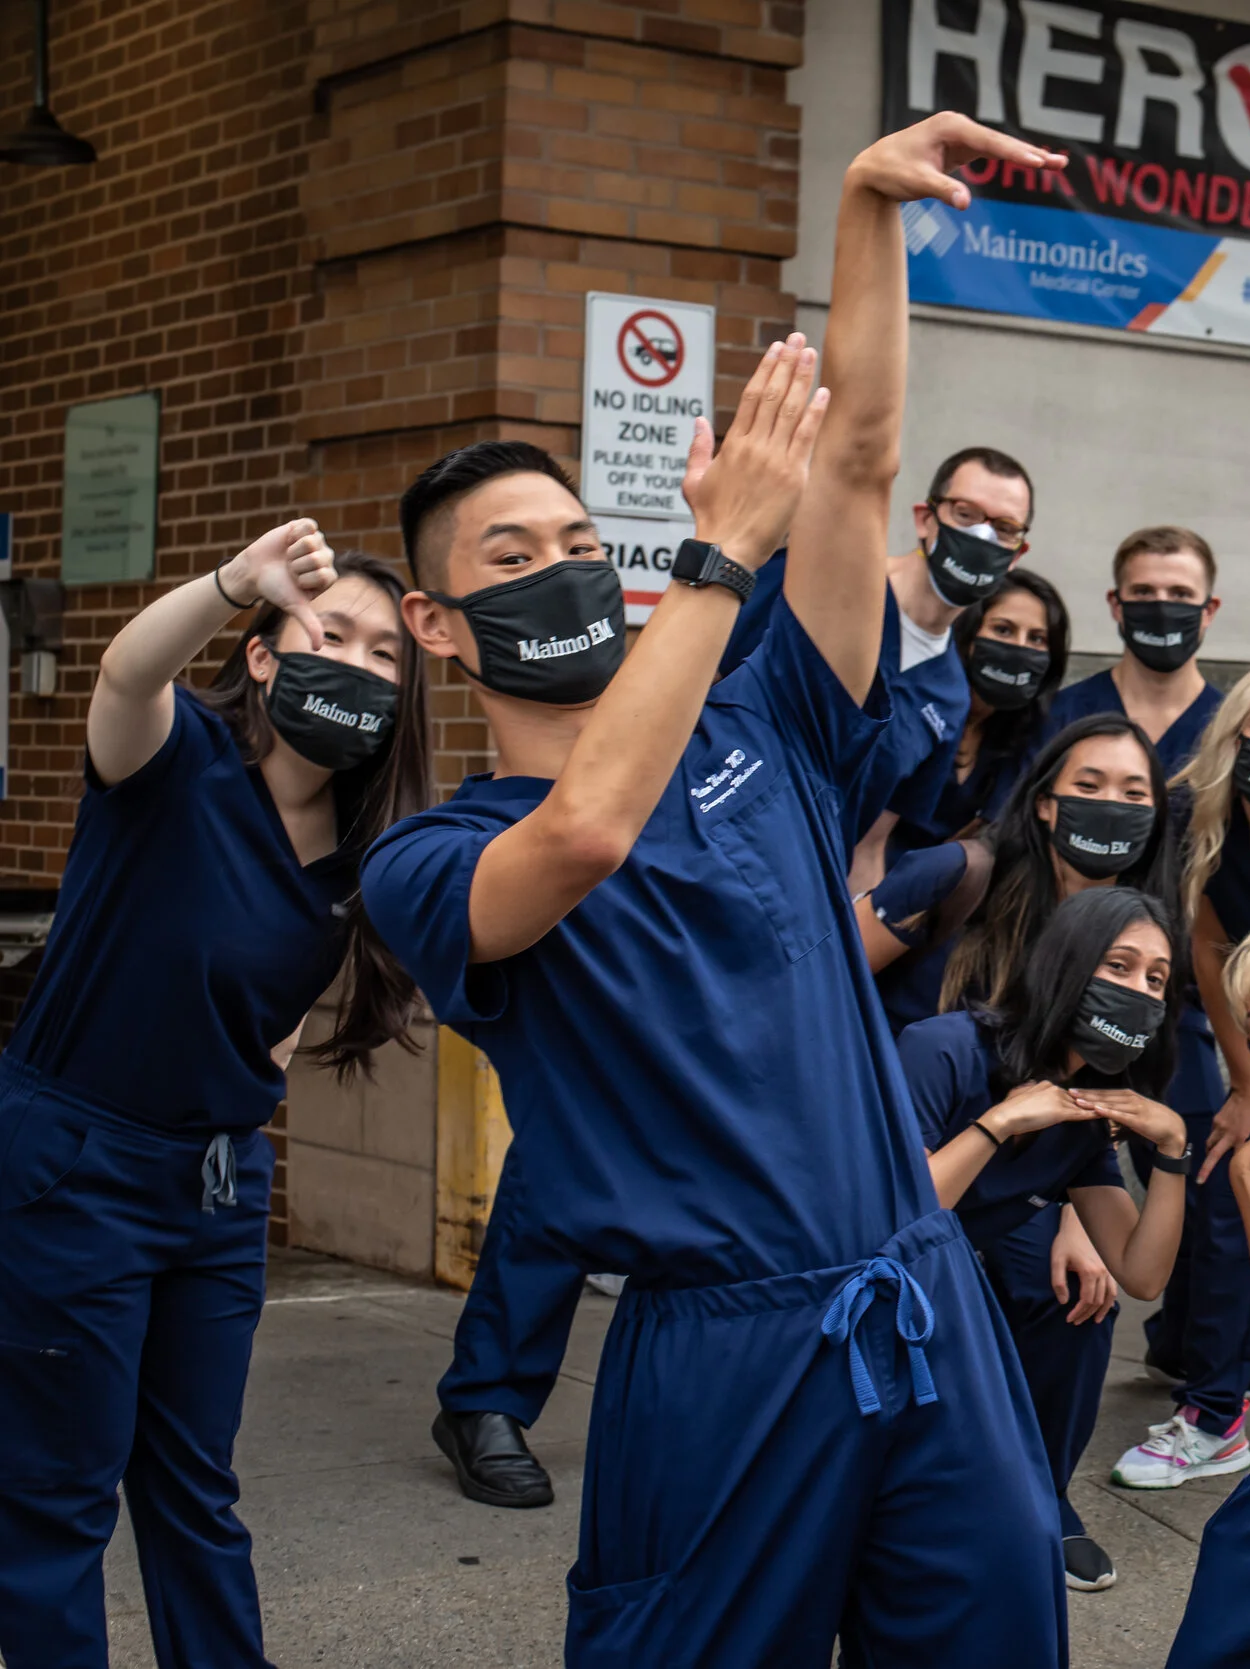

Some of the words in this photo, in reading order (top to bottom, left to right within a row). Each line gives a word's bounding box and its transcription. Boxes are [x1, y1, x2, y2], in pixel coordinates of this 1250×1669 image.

[963, 221, 1149, 279] Maimonides
[1029, 270, 1090, 295] Medical
[593, 389, 626, 411] NO
[632, 393, 704, 418] IDLING
[617, 421, 678, 446] ZONE
[592, 450, 653, 470] PLEASE
[659, 455, 687, 471] TUR
[607, 471, 638, 486] OFF
[616, 490, 676, 510] ENGINE
[600, 542, 673, 572] RIAG
[517, 635, 591, 662] Maimo
[586, 617, 616, 646] EM
[302, 693, 359, 728] Maimo
[357, 711, 383, 733] EM
[1069, 832, 1110, 856] Maimo
[1109, 840, 1132, 855] EM
[1090, 1014, 1134, 1047] Maimo
